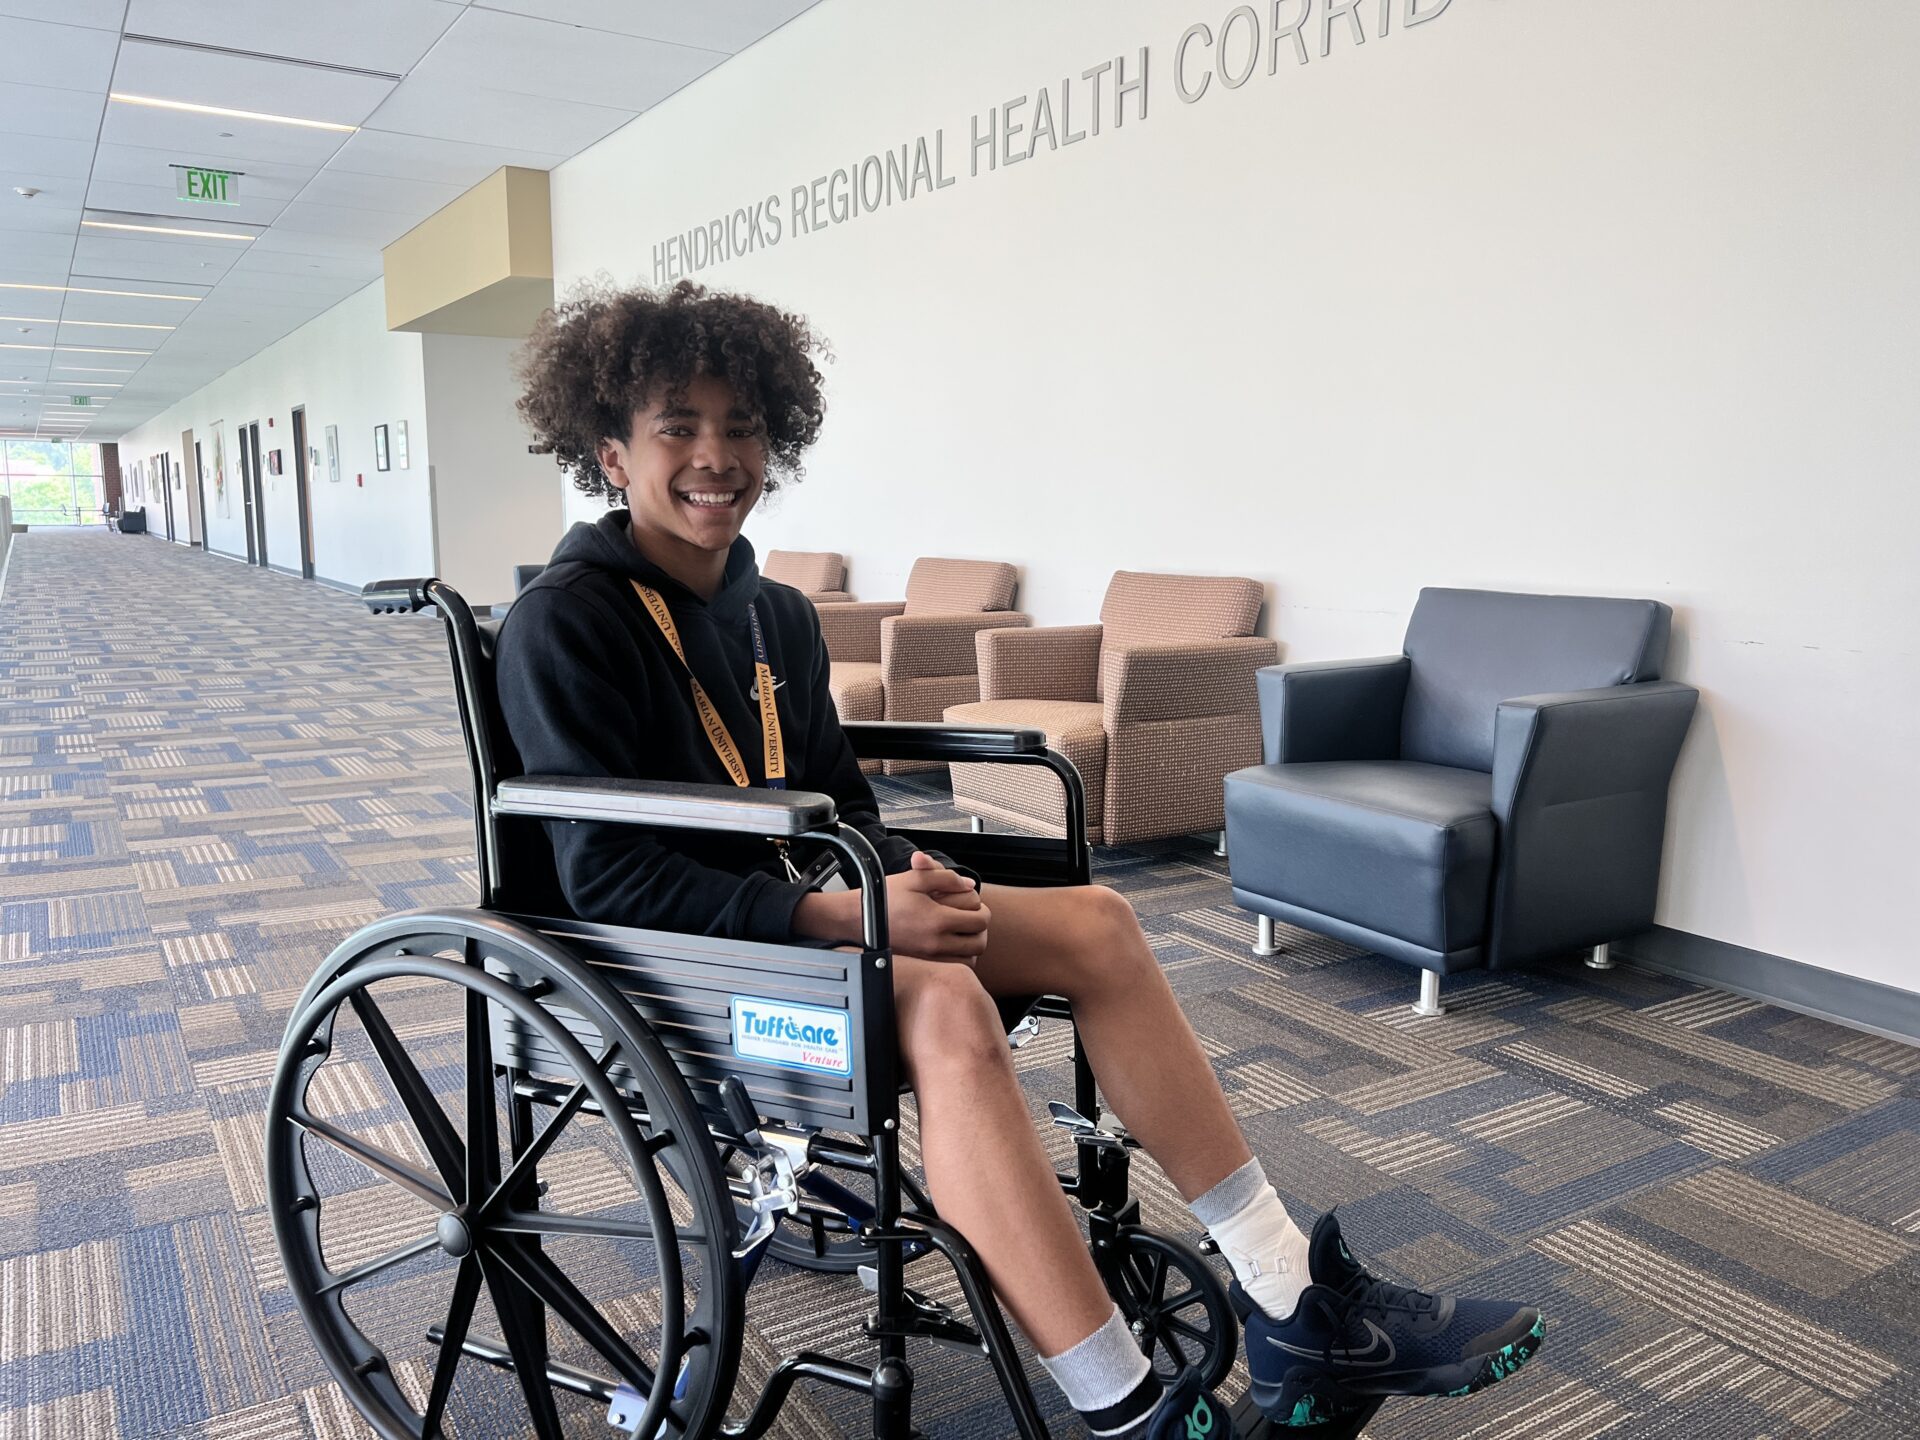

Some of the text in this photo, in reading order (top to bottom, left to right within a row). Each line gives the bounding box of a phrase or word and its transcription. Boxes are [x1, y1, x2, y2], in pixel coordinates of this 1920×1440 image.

[187, 170, 229, 201] EXIT
[652, 0, 1451, 285] HENDRICKS REGIONAL HEALTH CORR
[692, 682, 746, 784] MARIAN UNIVERSITY
[760, 666, 772, 709] MARIAN
[766, 712, 780, 774] UNIVERSITY
[802, 1051, 843, 1067] Venture
